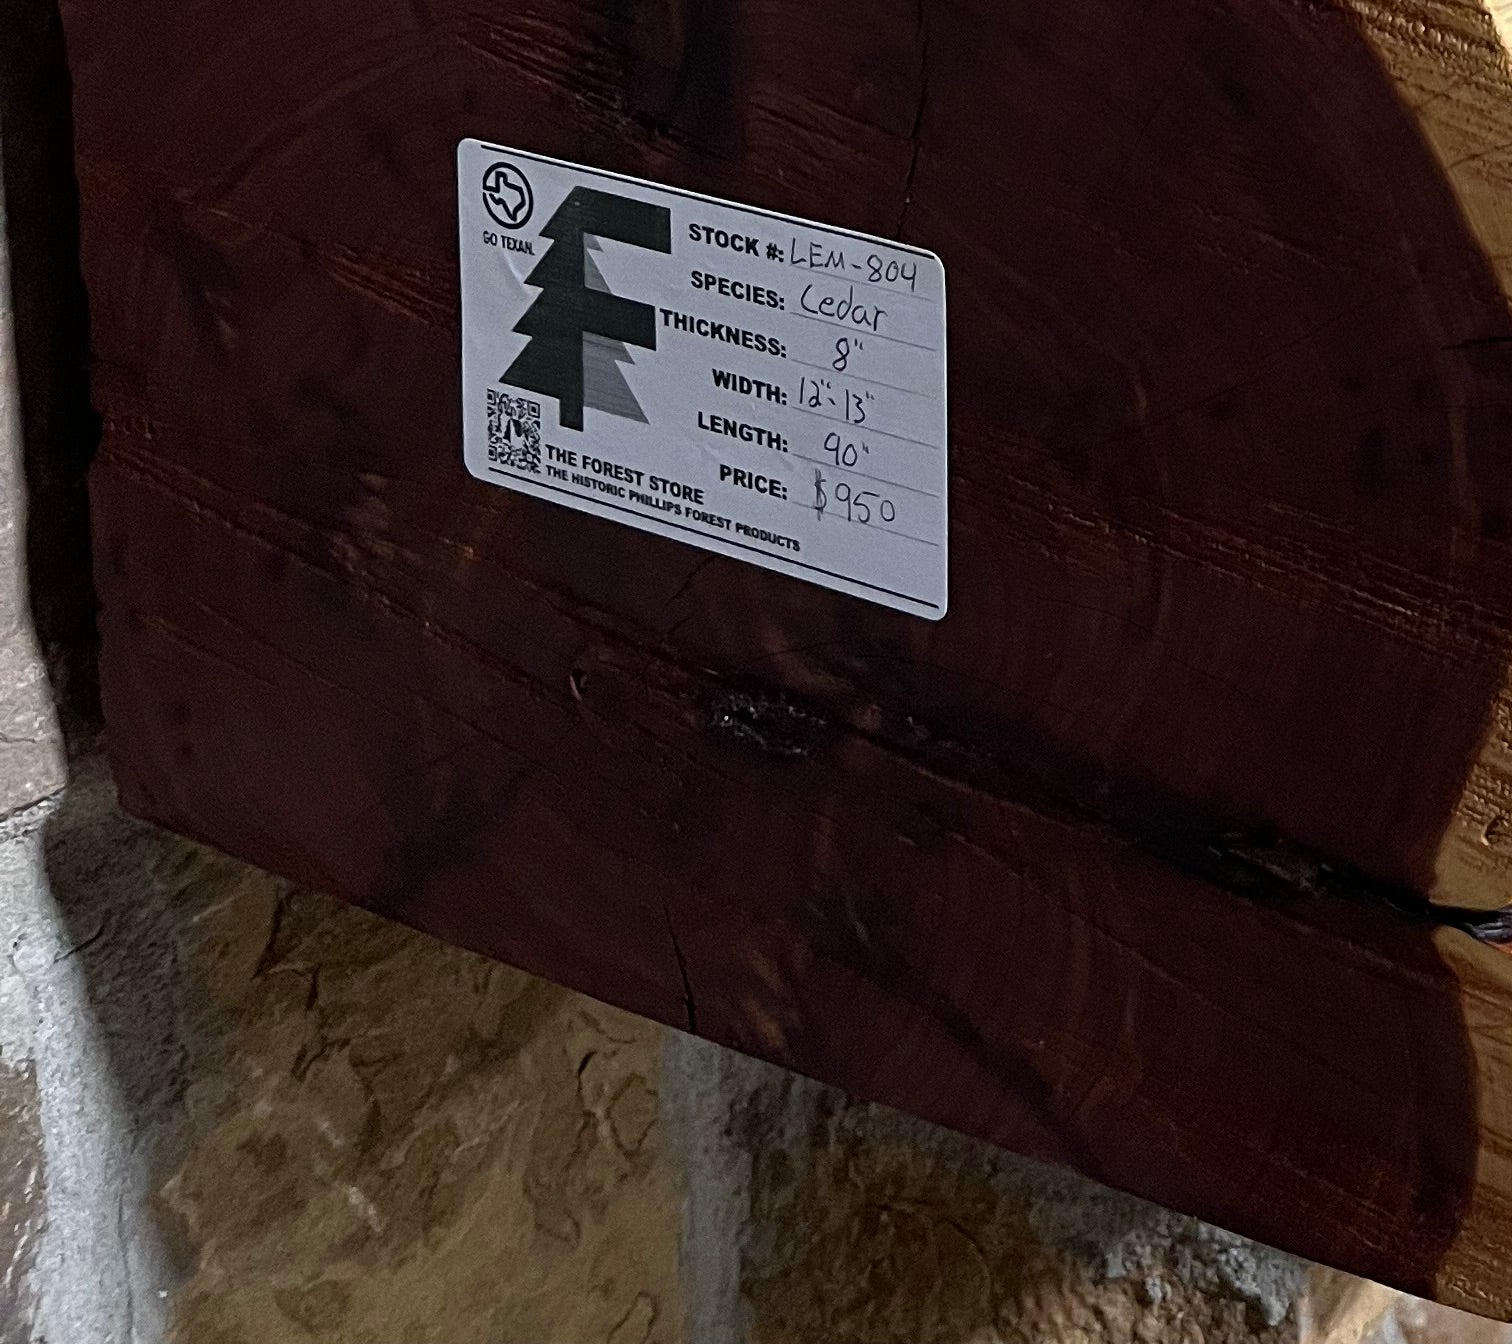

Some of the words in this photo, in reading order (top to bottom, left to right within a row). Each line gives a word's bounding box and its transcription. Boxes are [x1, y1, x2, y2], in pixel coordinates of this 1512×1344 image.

[483, 230, 498, 246] GO
[688, 223, 760, 257] STOCK
[766, 242, 784, 263] #:
[690, 270, 785, 311] SPECIES:
[800, 284, 888, 331] Cedar
[659, 308, 787, 359] THICKNESS:
[832, 337, 864, 372] 8"
[711, 368, 788, 406] WIDTH:
[697, 411, 789, 453] LENGTH:
[545, 444, 577, 466] THE
[582, 455, 645, 486] FOREST
[649, 476, 705, 505] STORE
[719, 464, 788, 500] PRICE:
[813, 468, 896, 523] $950
[546, 464, 569, 481] THE
[571, 473, 626, 498] HISTORIC
[629, 490, 682, 516] PHILLIPS
[685, 507, 732, 531] FOREST
[735, 522, 801, 552] PRODUCTS
